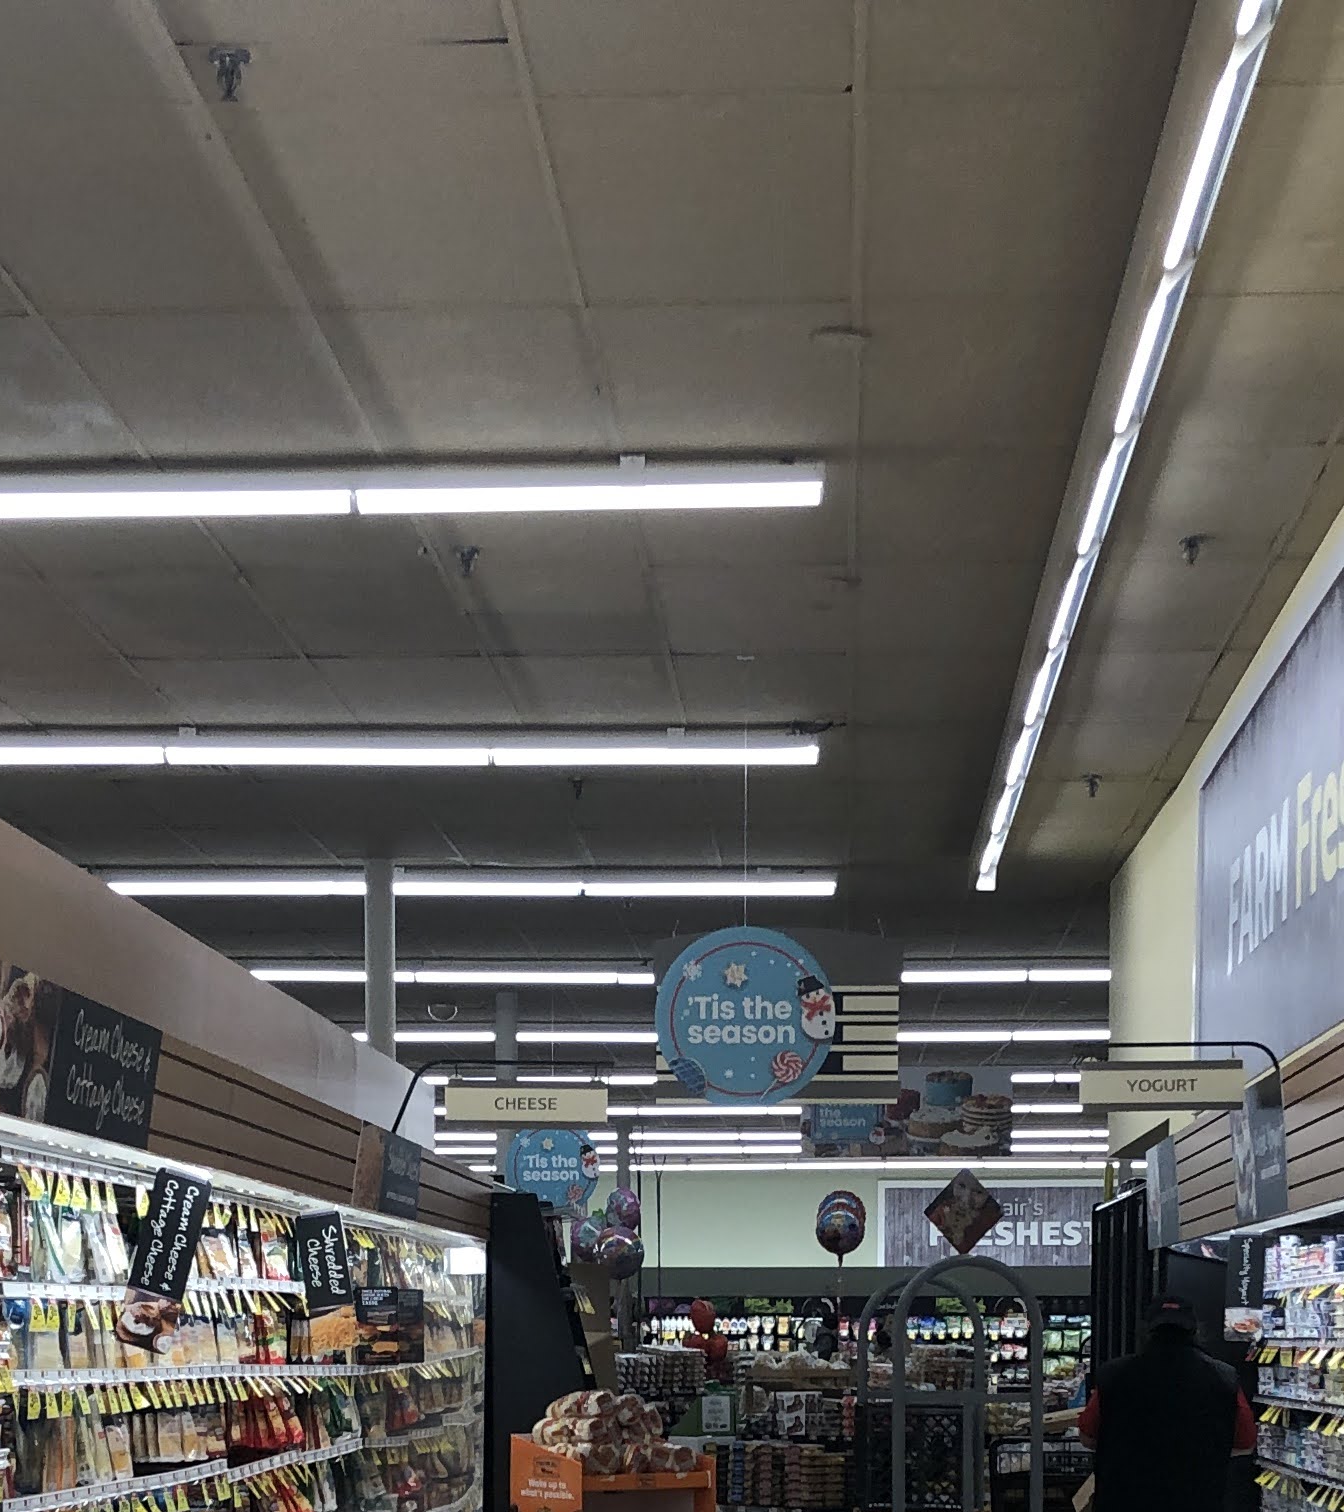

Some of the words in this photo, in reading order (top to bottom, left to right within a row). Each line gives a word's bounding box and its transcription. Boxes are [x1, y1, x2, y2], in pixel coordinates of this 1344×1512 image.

[1225, 798, 1290, 979] FARM
[743, 995, 793, 1022] the
[74, 1009, 111, 1054] Cream
[110, 1020, 145, 1073] Cheese
[686, 1024, 797, 1045] season
[66, 1062, 112, 1131] Cottage
[112, 1075, 145, 1126] Cheese
[494, 1097, 558, 1111] CHEESE
[1125, 1077, 1199, 1094] YOGURT
[522, 1168, 580, 1182] season
[551, 1155, 578, 1169] the
[151, 1179, 179, 1234] Cottage
[181, 1185, 200, 1231] Cream
[140, 1237, 164, 1287] Cheese
[164, 1231, 187, 1281] Cheese
[306, 1238, 323, 1288] Cheese
[321, 1224, 347, 1296] Shredded
